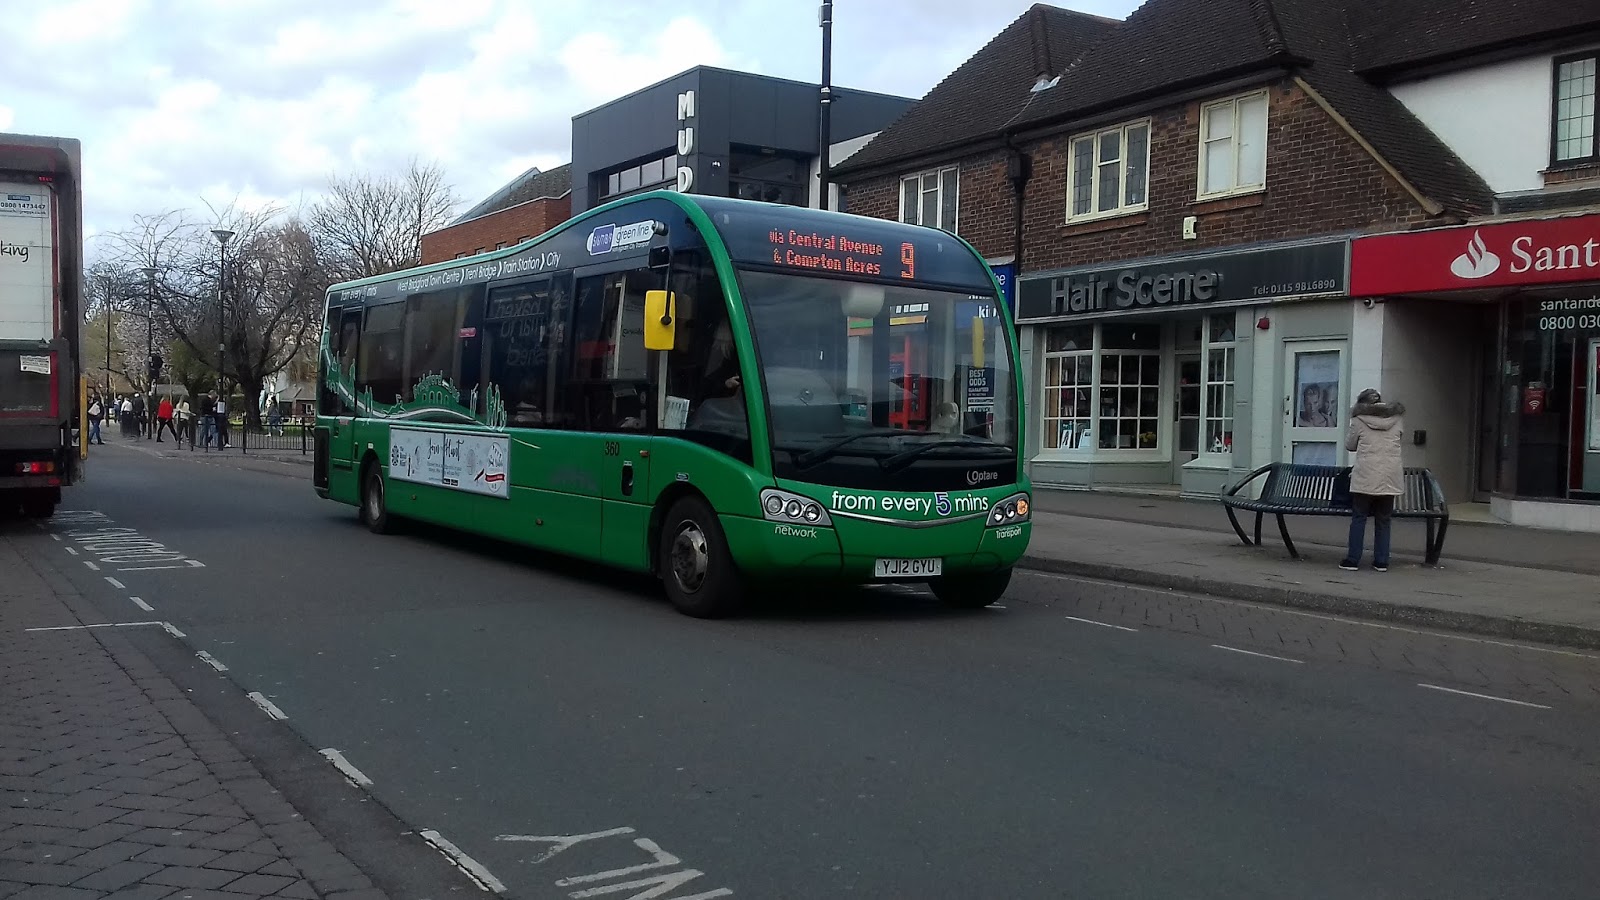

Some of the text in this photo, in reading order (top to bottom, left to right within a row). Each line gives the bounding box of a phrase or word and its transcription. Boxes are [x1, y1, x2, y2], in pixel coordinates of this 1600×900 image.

[616, 227, 637, 244] green
[769, 227, 883, 256] via Central Avenue
[773, 247, 881, 275] & Compton Acres
[901, 241, 915, 279] 9
[1510, 236, 1600, 273] Sant
[428, 274, 442, 287] Town
[441, 270, 460, 284] Centre
[465, 268, 478, 280] Trent
[478, 265, 497, 279] Bridge
[503, 258, 518, 274] Train
[517, 255, 540, 272] Station
[546, 251, 561, 268] City
[1051, 268, 1214, 313] Hair Scene
[1253, 279, 1336, 295] Tel: 0115 9816890
[1540, 315, 1575, 330] 0800
[969, 369, 985, 378] BEST
[604, 441, 620, 456] 360
[971, 470, 998, 483] Optare
[832, 491, 988, 516] from every 5 mins
[774, 524, 817, 539] network
[995, 526, 1022, 539] Transport
[882, 559, 936, 574] YJ12 GYU
